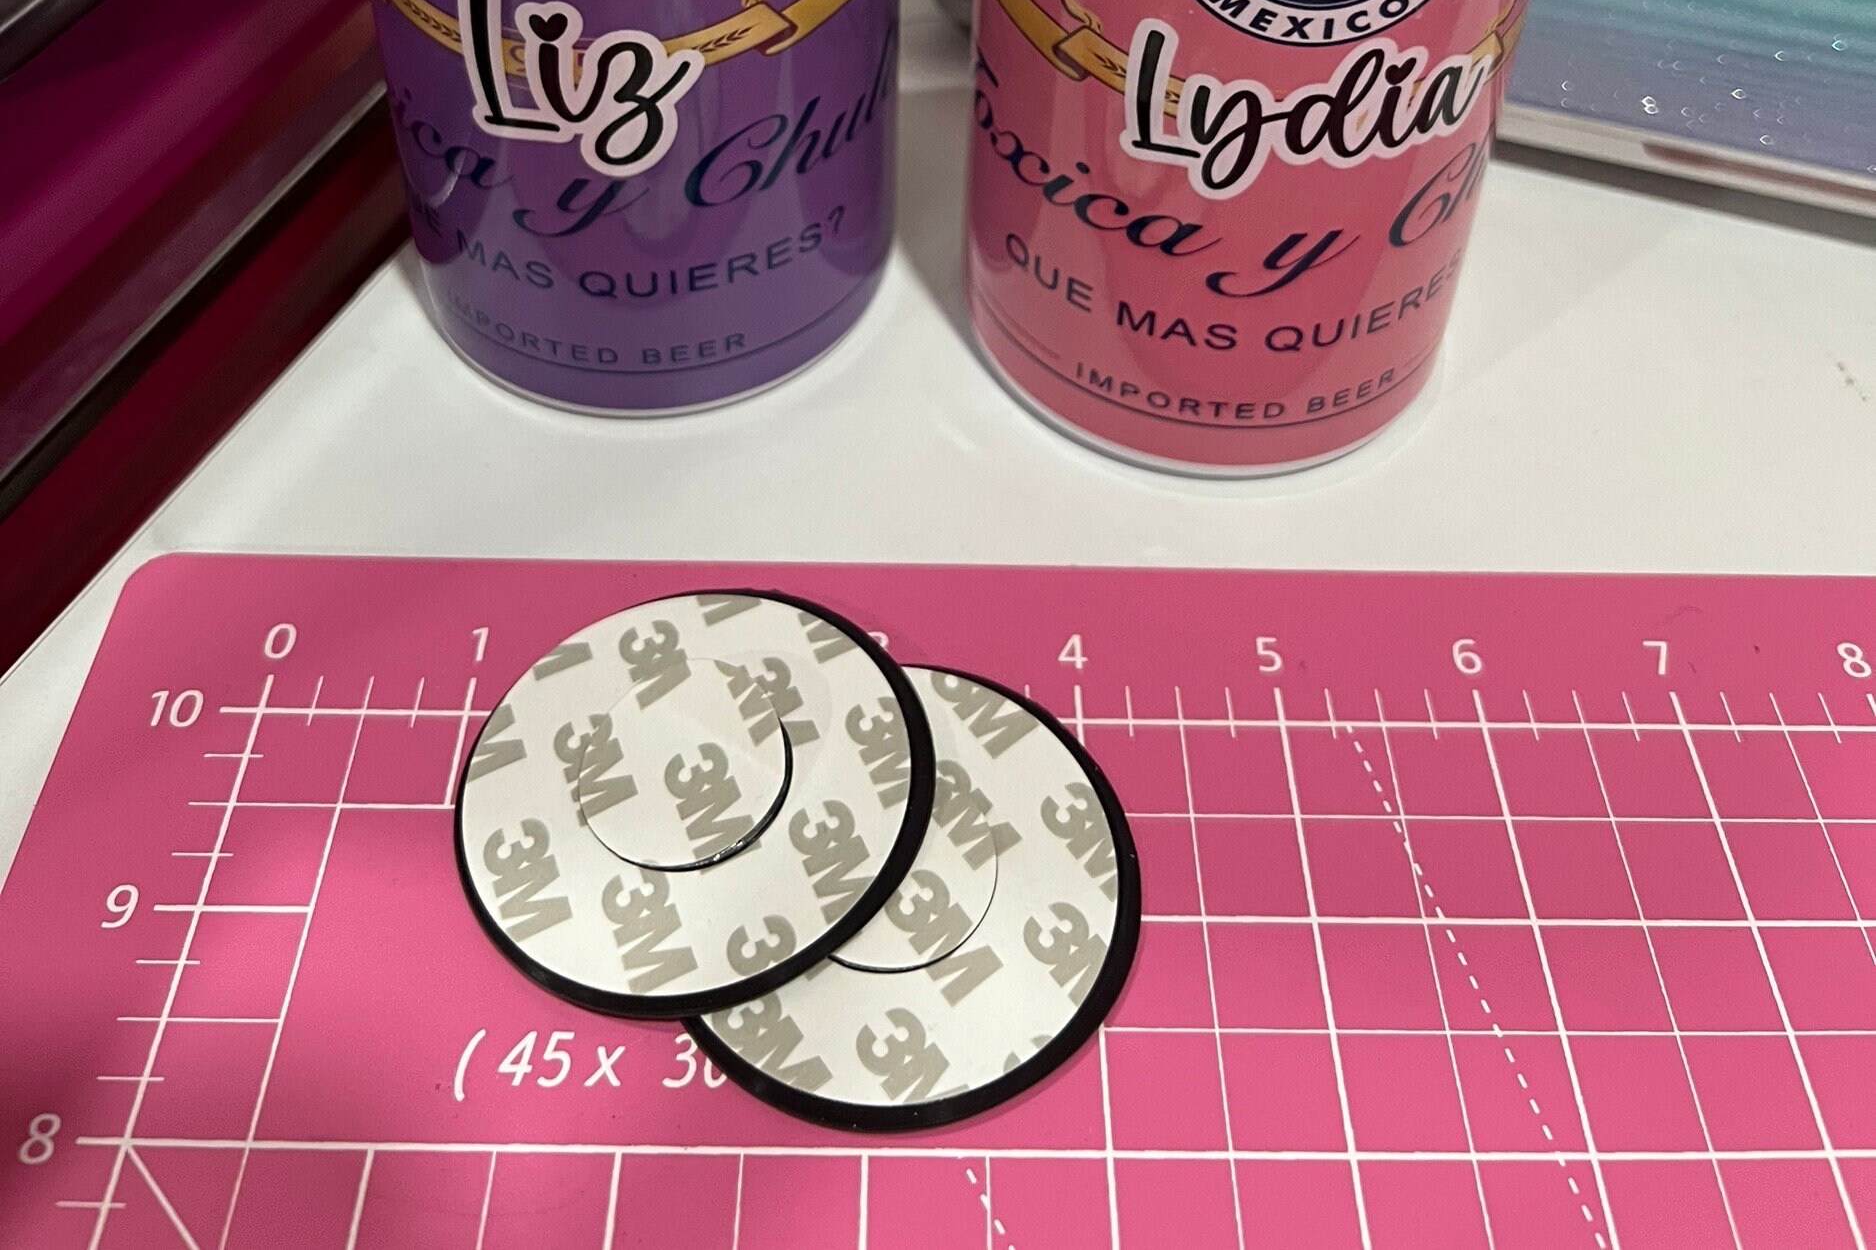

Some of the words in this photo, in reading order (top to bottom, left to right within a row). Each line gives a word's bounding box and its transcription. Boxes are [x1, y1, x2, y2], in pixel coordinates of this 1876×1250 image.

[1131, 29, 1486, 190] Lydia
[512, 177, 651, 238] y
[456, 227, 555, 290] MAS
[578, 203, 846, 299] QUIERES?
[1005, 233, 1094, 313] QUE
[1116, 300, 1238, 351] MAS
[1205, 228, 1362, 299] y
[641, 332, 747, 366] BEER
[1076, 362, 1286, 421] IMPORTED
[1305, 367, 1397, 416] BEER
[263, 622, 297, 660] 0
[472, 626, 490, 663] 1
[1057, 634, 1089, 671] 4
[1255, 636, 1283, 673] 5
[1452, 638, 1483, 675] 6
[1643, 640, 1670, 677] 7
[1837, 641, 1875, 679] 8
[618, 619, 693, 712] 3M
[149, 688, 205, 729] 10
[553, 713, 639, 828] 3M
[664, 741, 762, 875] 3M
[101, 883, 139, 929] 9
[483, 818, 573, 941] 3M
[601, 860, 699, 994] 3M
[884, 869, 1005, 1008] 3M
[583, 1045, 627, 1088] x
[18, 1112, 61, 1165] 8
